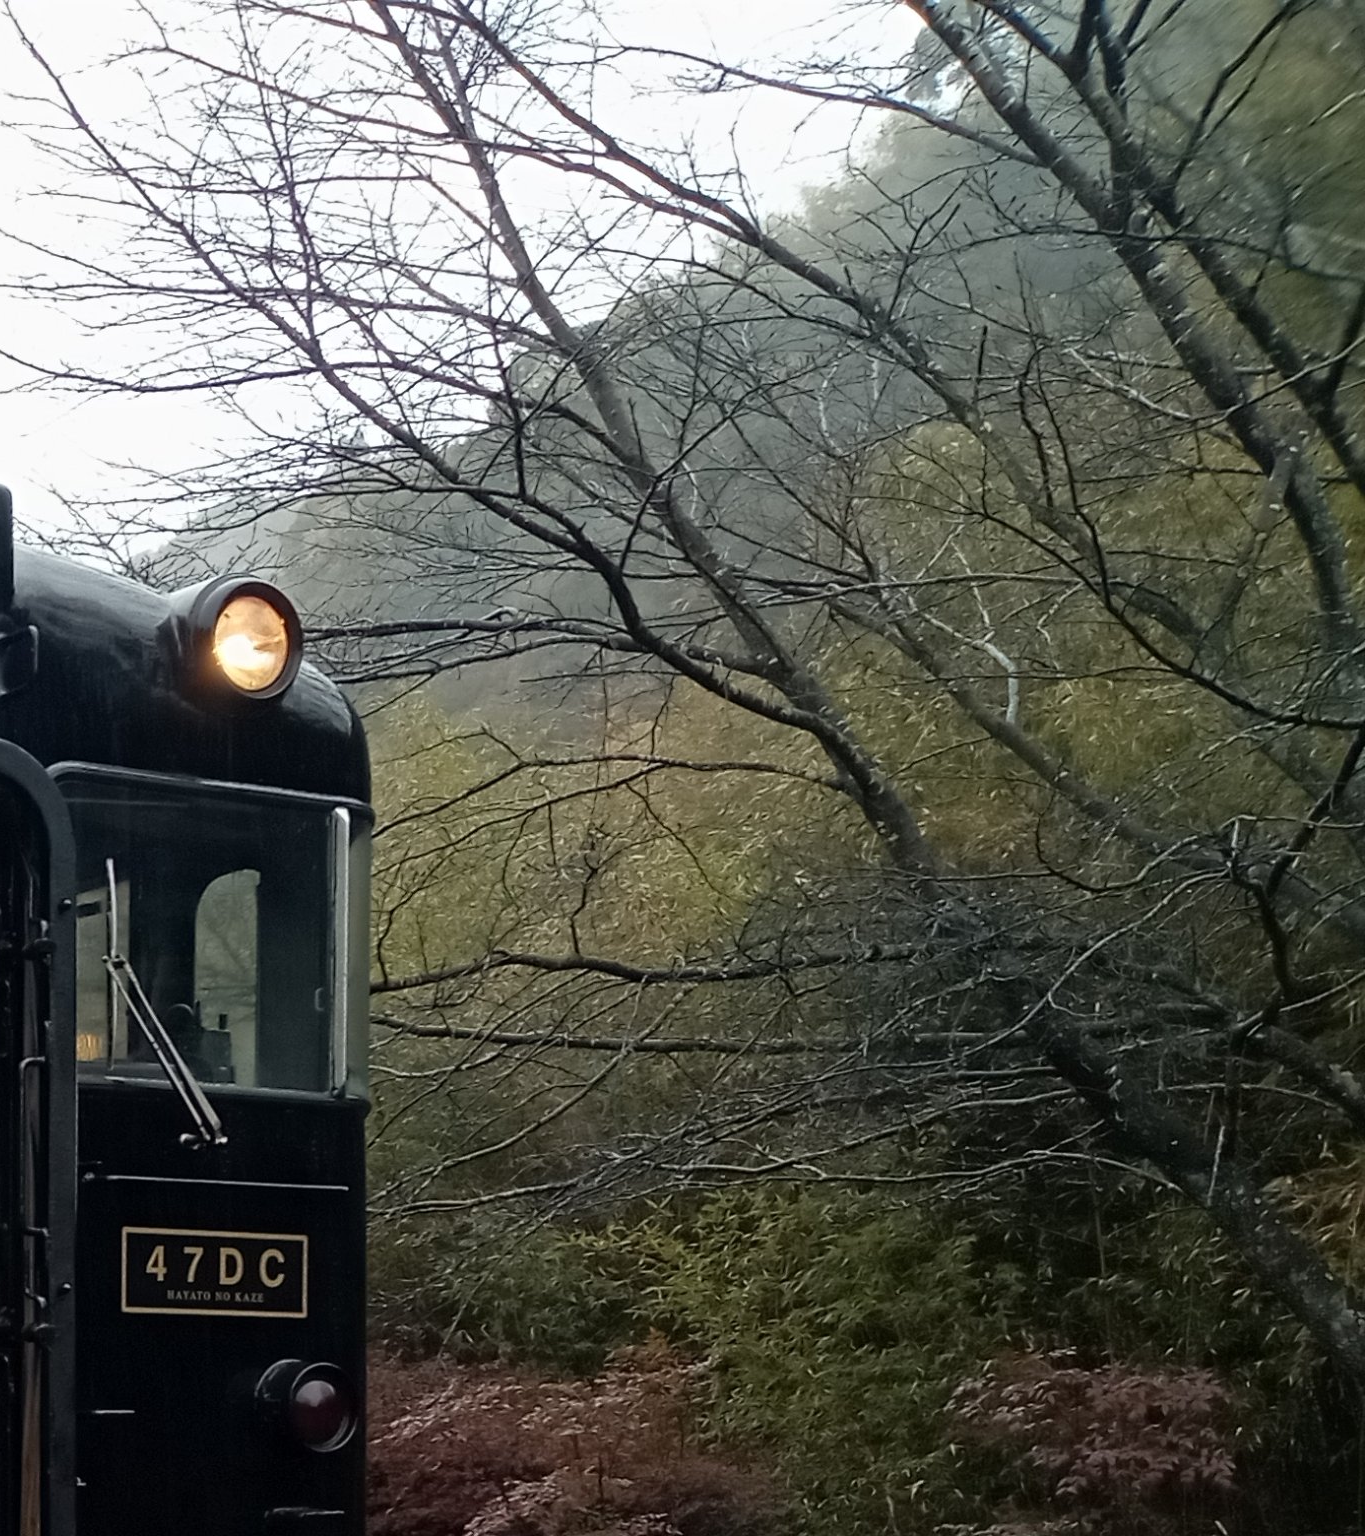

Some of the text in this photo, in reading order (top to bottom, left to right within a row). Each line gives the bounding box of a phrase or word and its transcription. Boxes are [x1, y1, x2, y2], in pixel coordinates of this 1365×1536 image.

[145, 1245, 286, 1288] 47DC
[167, 1289, 265, 1303] HAYATO NO KAZE
